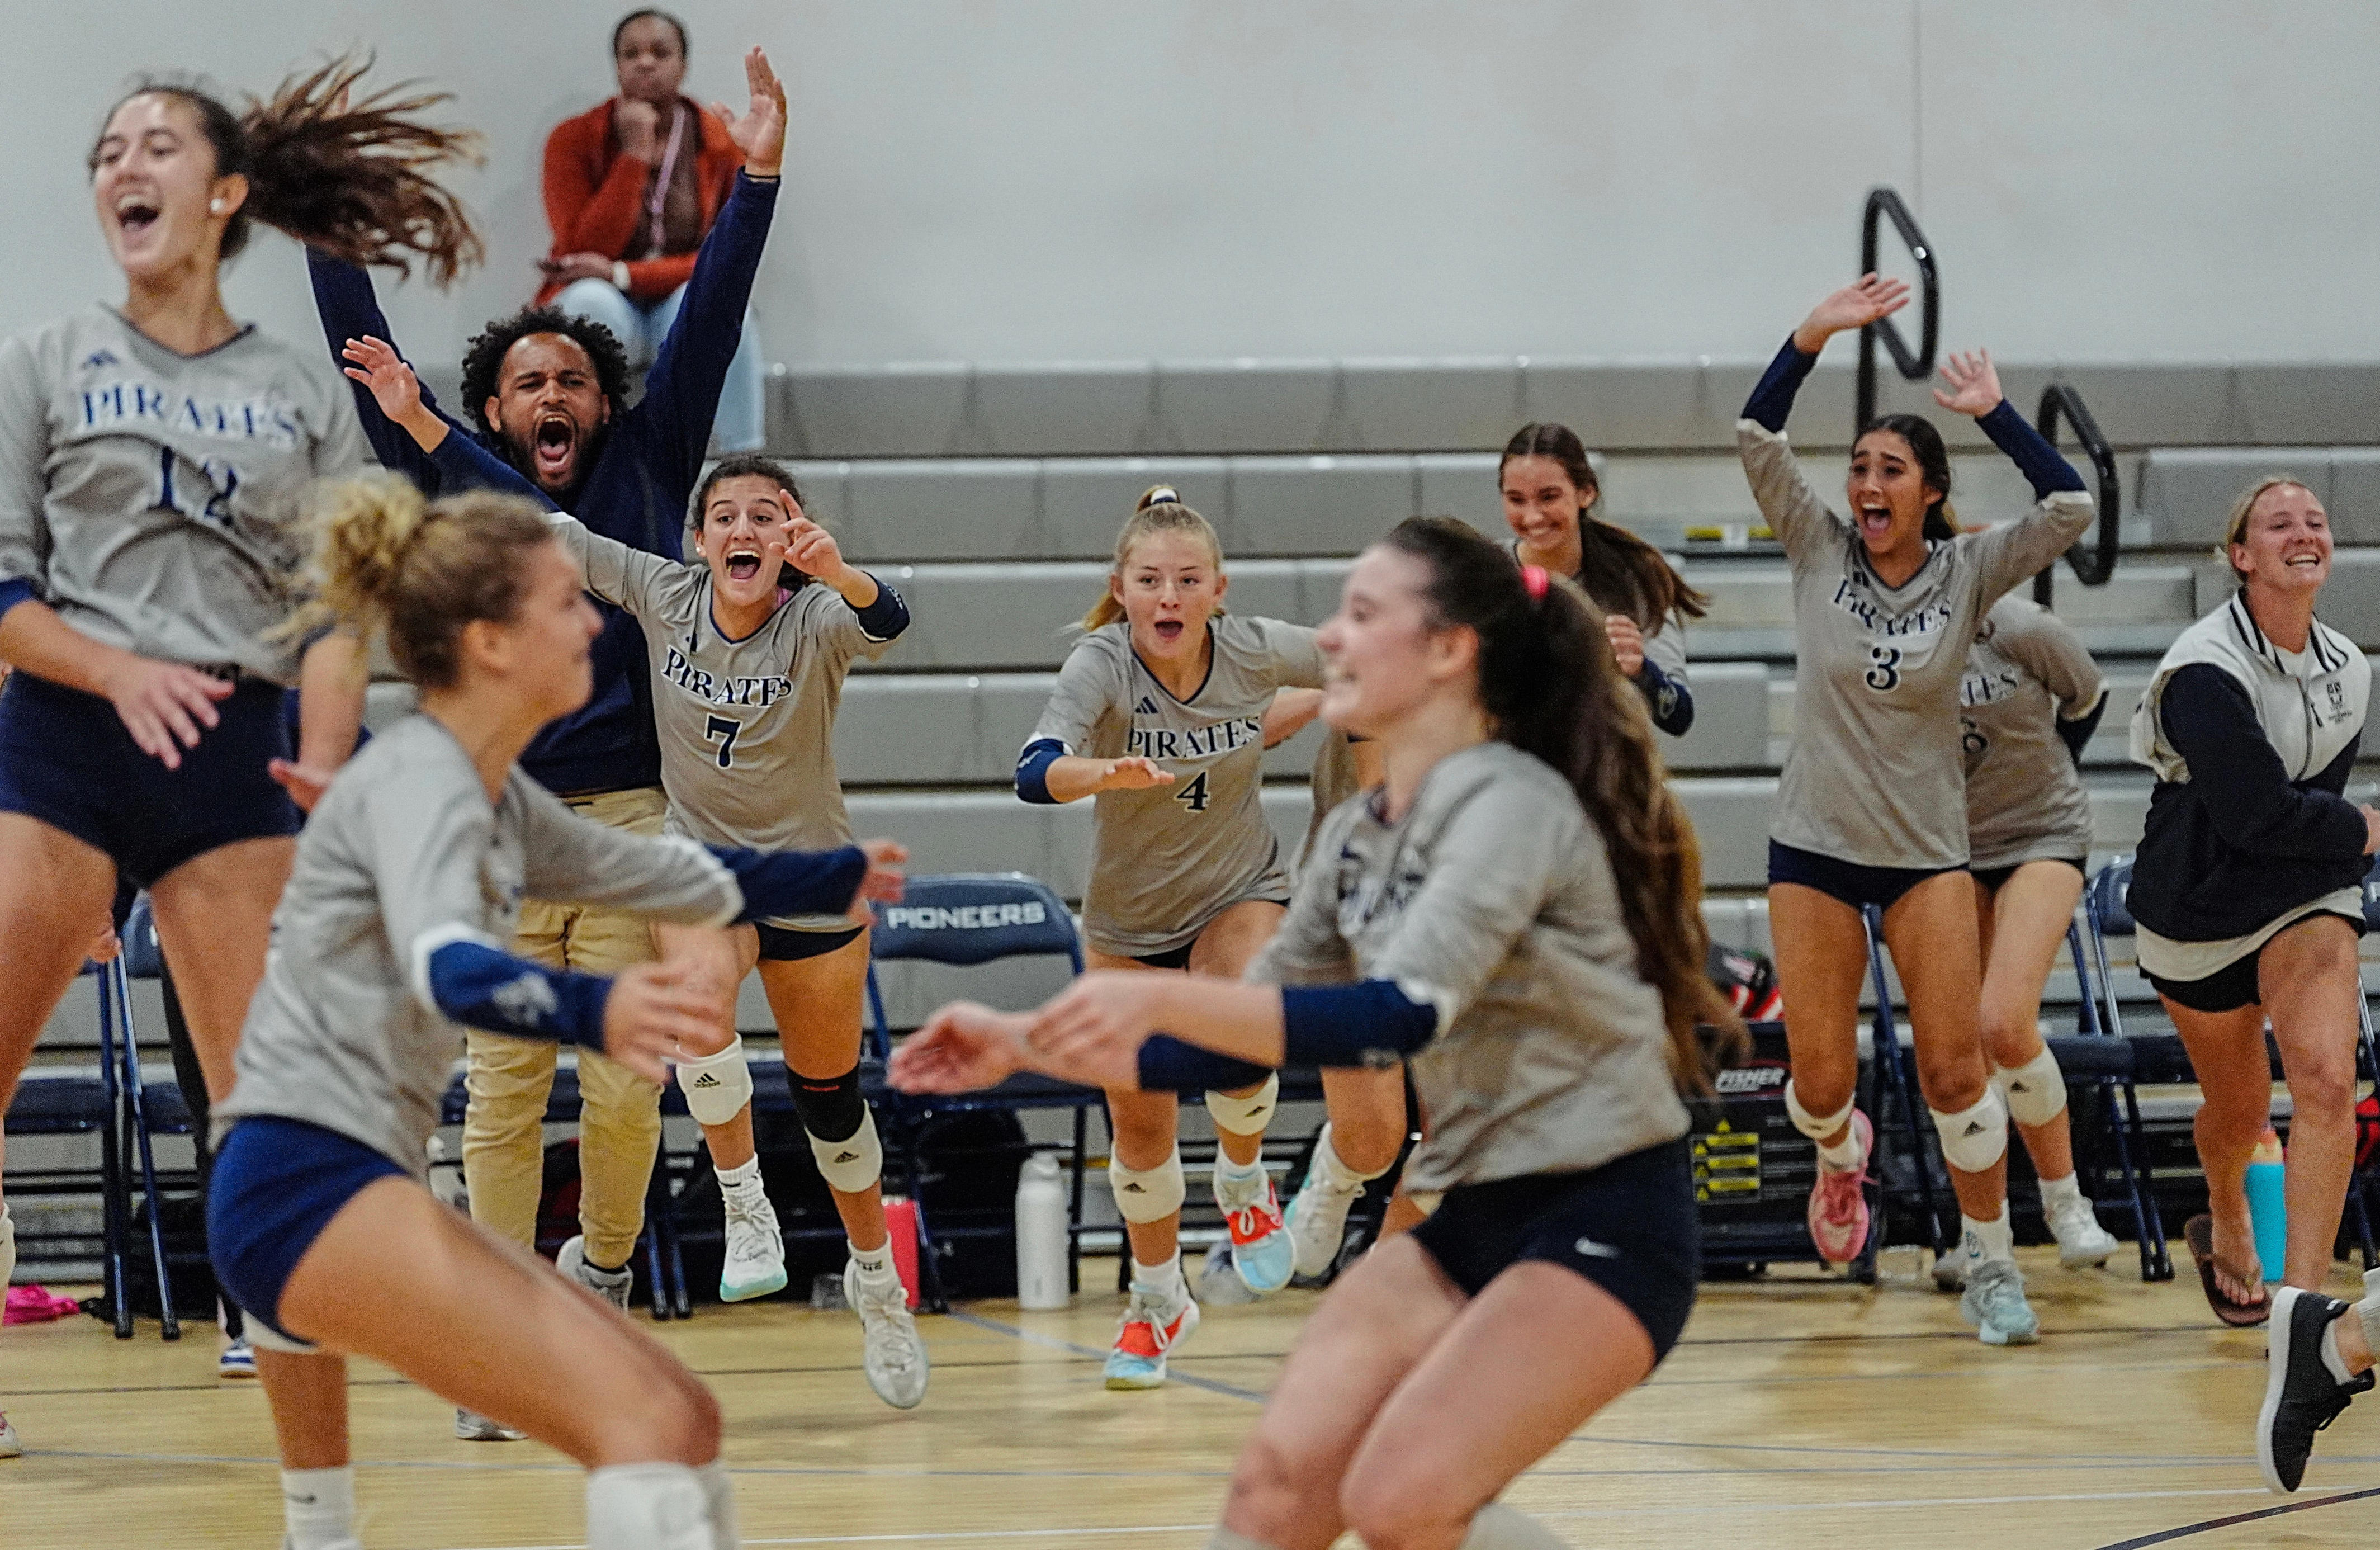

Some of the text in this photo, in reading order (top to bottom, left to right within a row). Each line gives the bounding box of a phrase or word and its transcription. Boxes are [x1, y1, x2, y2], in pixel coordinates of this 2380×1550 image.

[82, 385, 297, 448] PIRATES
[146, 446, 239, 527] 12
[661, 645, 794, 708] PIRATES
[1865, 646, 1901, 693] 3
[703, 712, 743, 769] 7
[1124, 715, 1261, 759] PIRATES
[1175, 769, 1211, 812] 4
[887, 901, 1046, 929] PIONEERS
